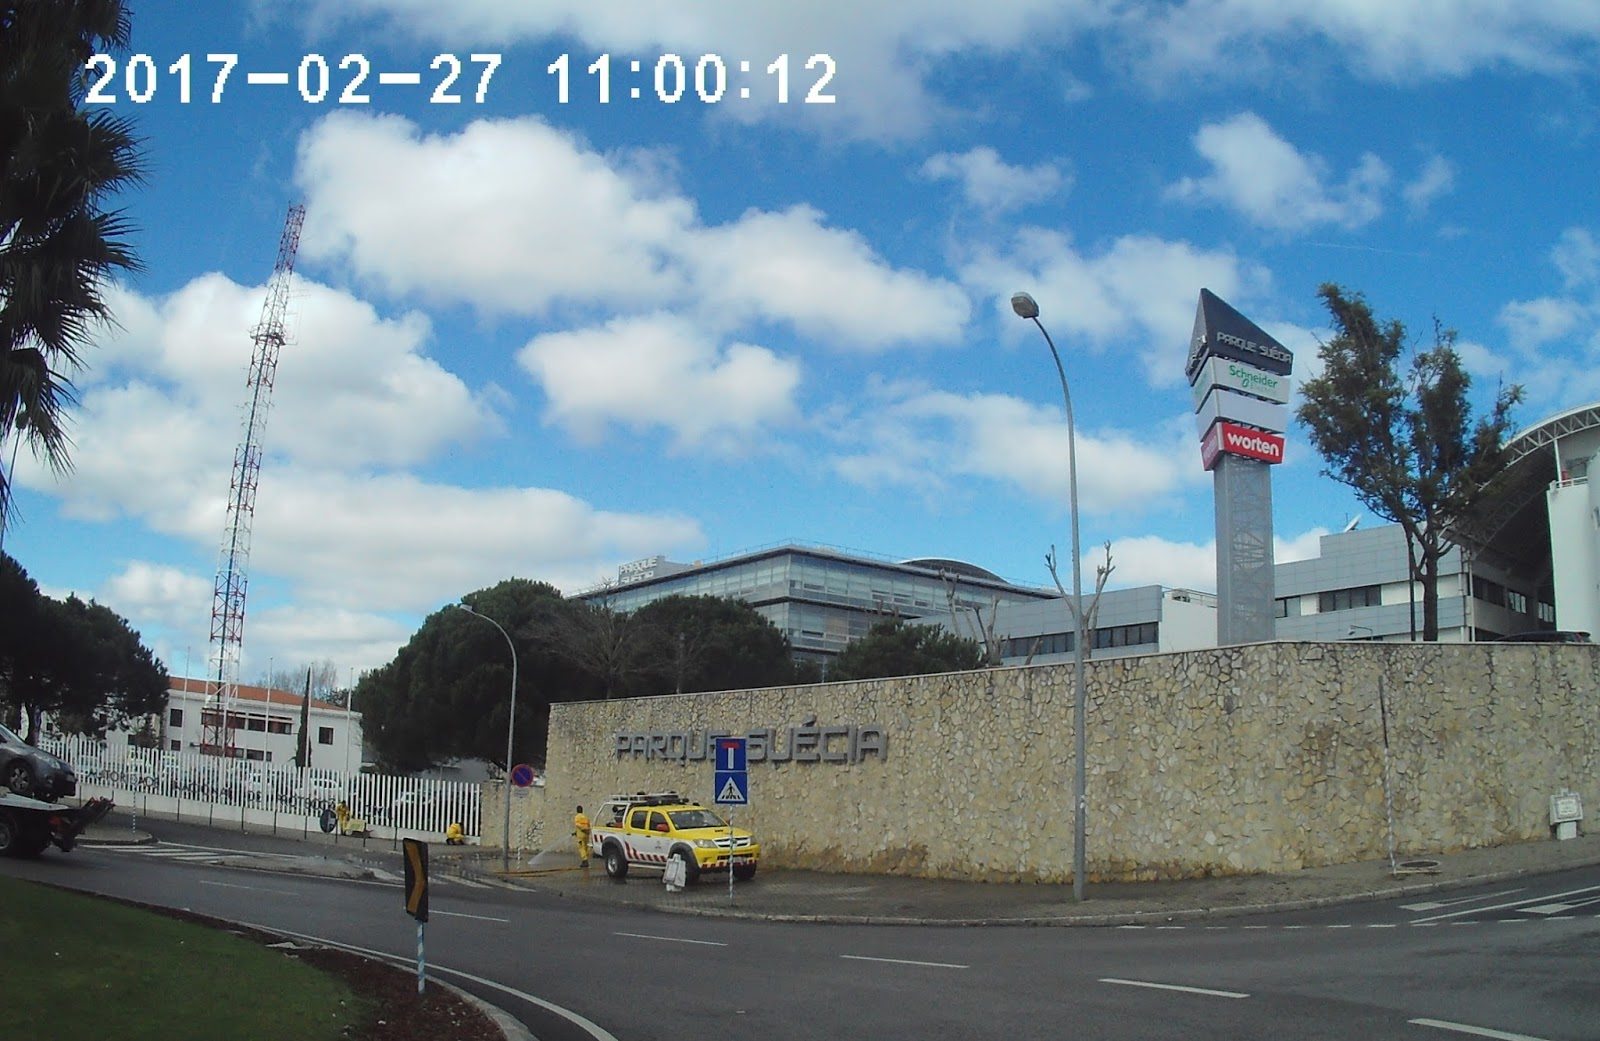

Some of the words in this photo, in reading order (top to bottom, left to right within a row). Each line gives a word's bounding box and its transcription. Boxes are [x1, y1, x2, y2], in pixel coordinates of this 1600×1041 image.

[1216, 331, 1257, 353] PARQUE
[1228, 364, 1279, 389] Schneider
[1227, 432, 1280, 457] worten
[747, 713, 887, 765] SUÉCIA
